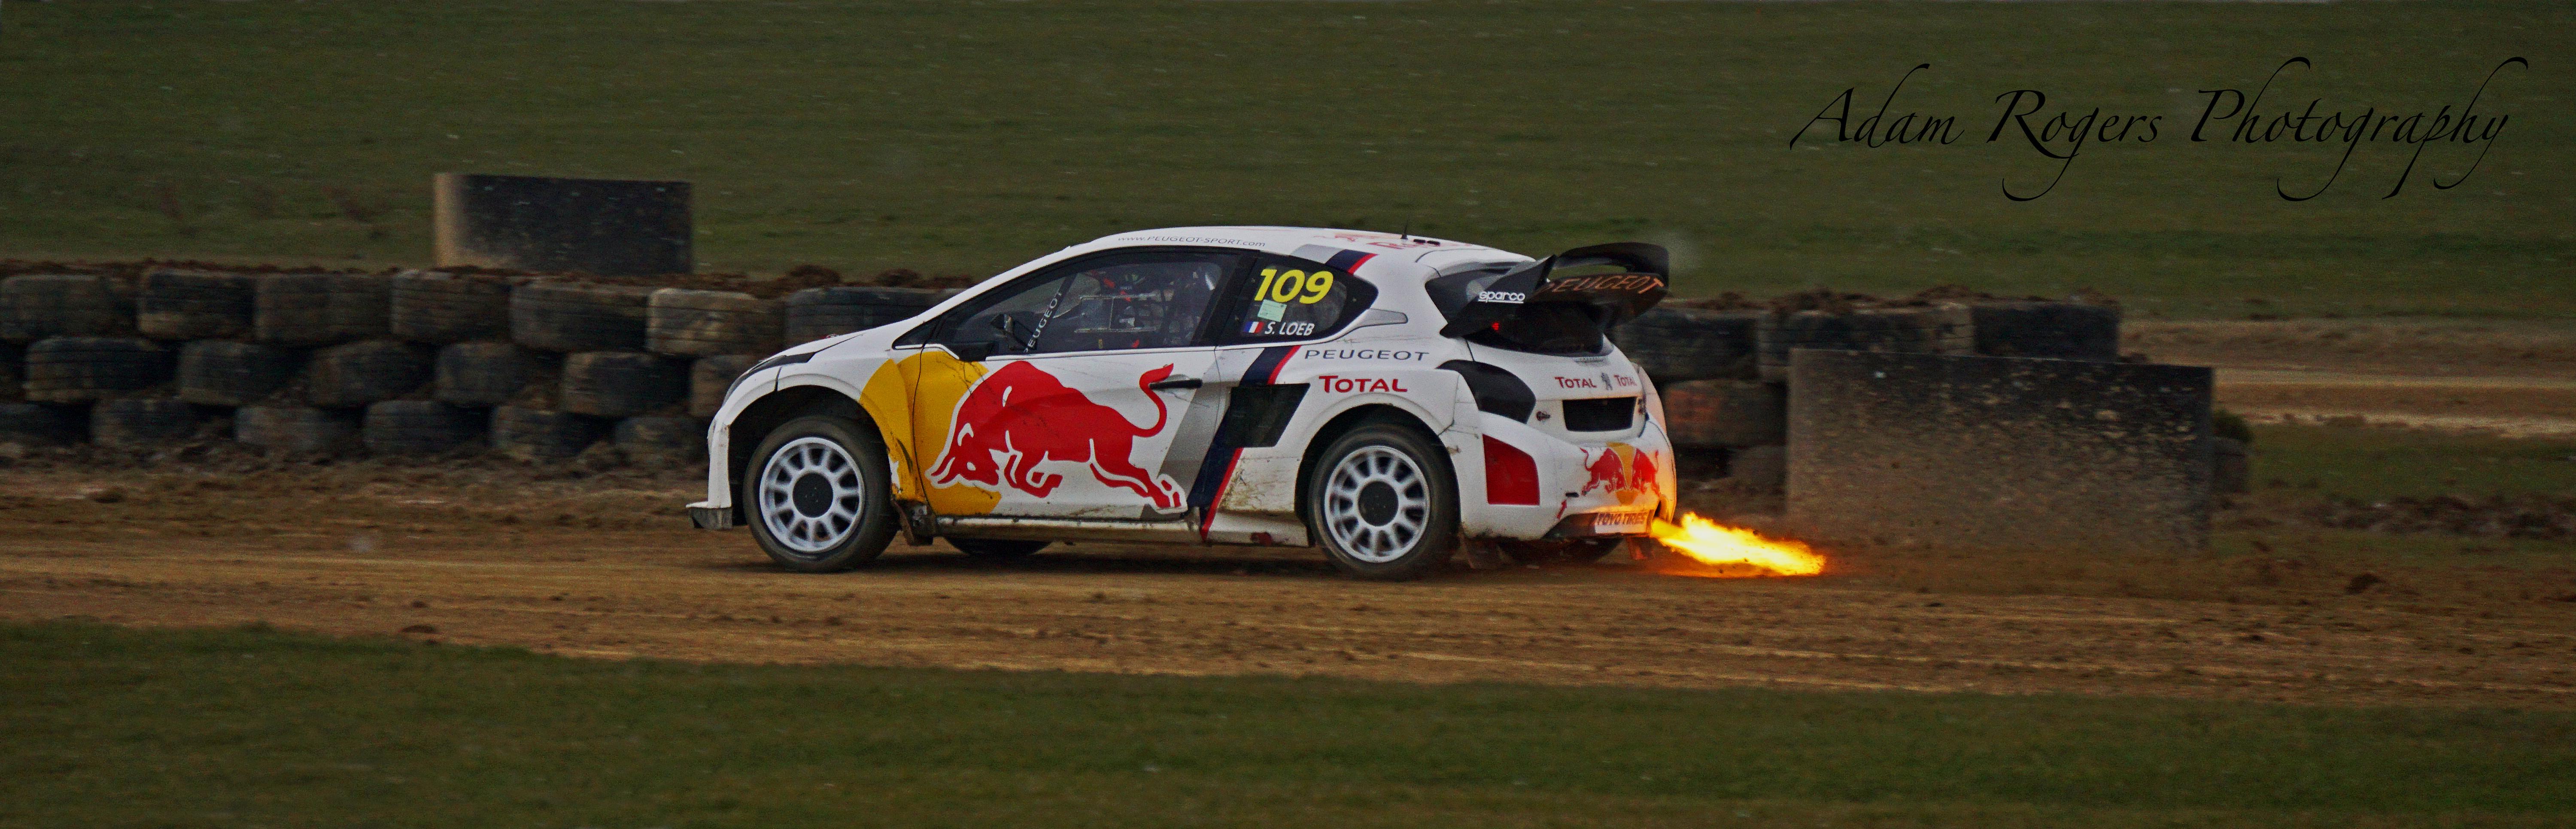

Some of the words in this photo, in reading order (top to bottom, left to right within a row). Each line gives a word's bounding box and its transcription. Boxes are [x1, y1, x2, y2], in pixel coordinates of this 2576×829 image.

[1118, 236, 1266, 247] www.PEUGEOT-SPORT.com
[1254, 268, 1334, 305] 109
[1478, 290, 1526, 303] sparco
[1264, 321, 1276, 335] S.
[1279, 321, 1315, 336] LOEB
[1304, 349, 1430, 361] PEUGEOT
[1318, 375, 1408, 393] TOTAL
[1554, 376, 1598, 389] TOTAL
[1597, 512, 1622, 525] TOYO
